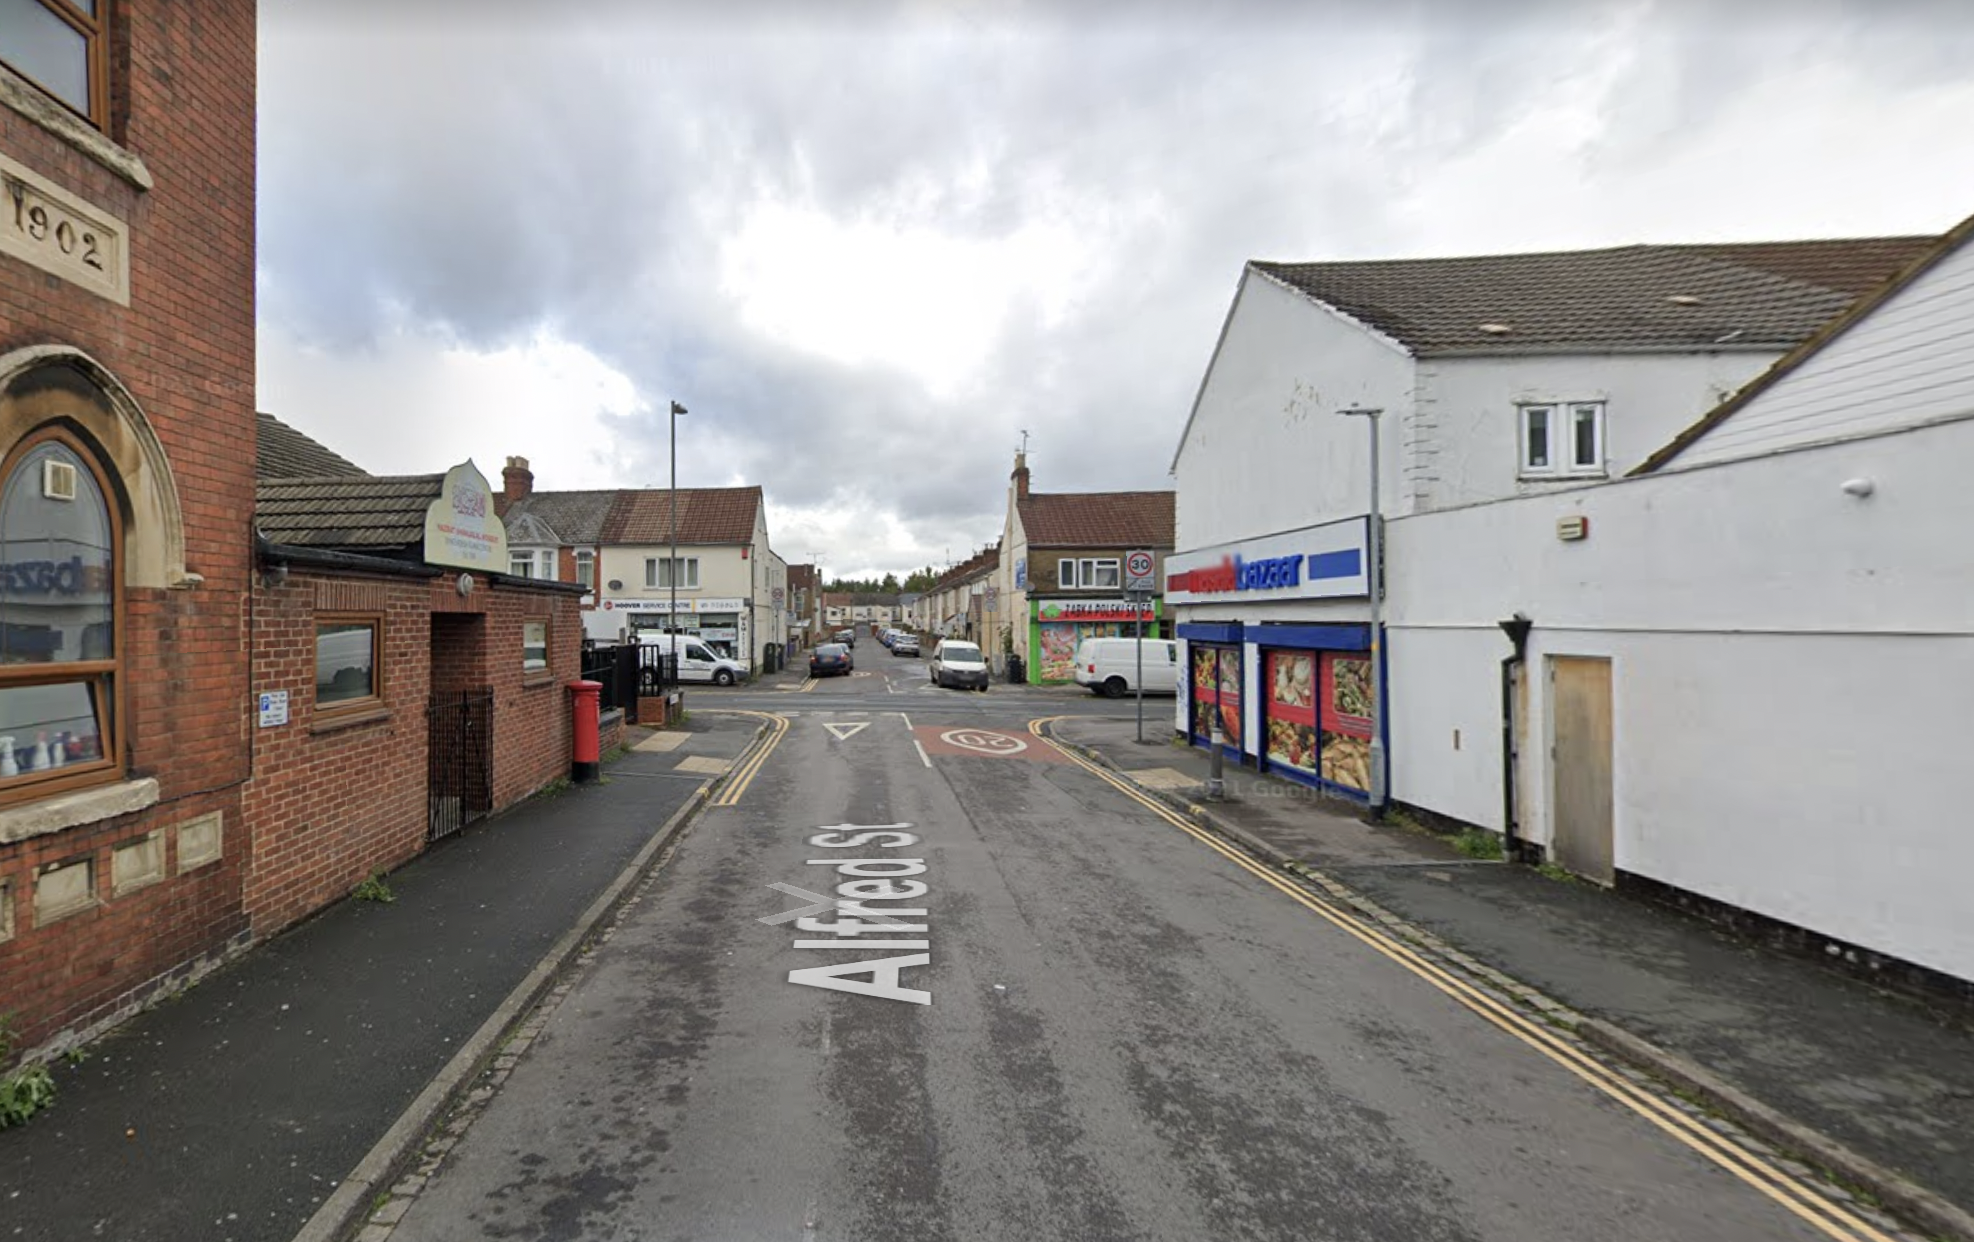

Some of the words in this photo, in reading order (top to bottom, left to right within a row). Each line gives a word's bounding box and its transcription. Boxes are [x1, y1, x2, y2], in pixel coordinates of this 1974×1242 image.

[5, 182, 103, 272] 1902
[1131, 559, 1149, 570] 30
[1235, 553, 1303, 590] bazaar
[957, 735, 1014, 747] 20
